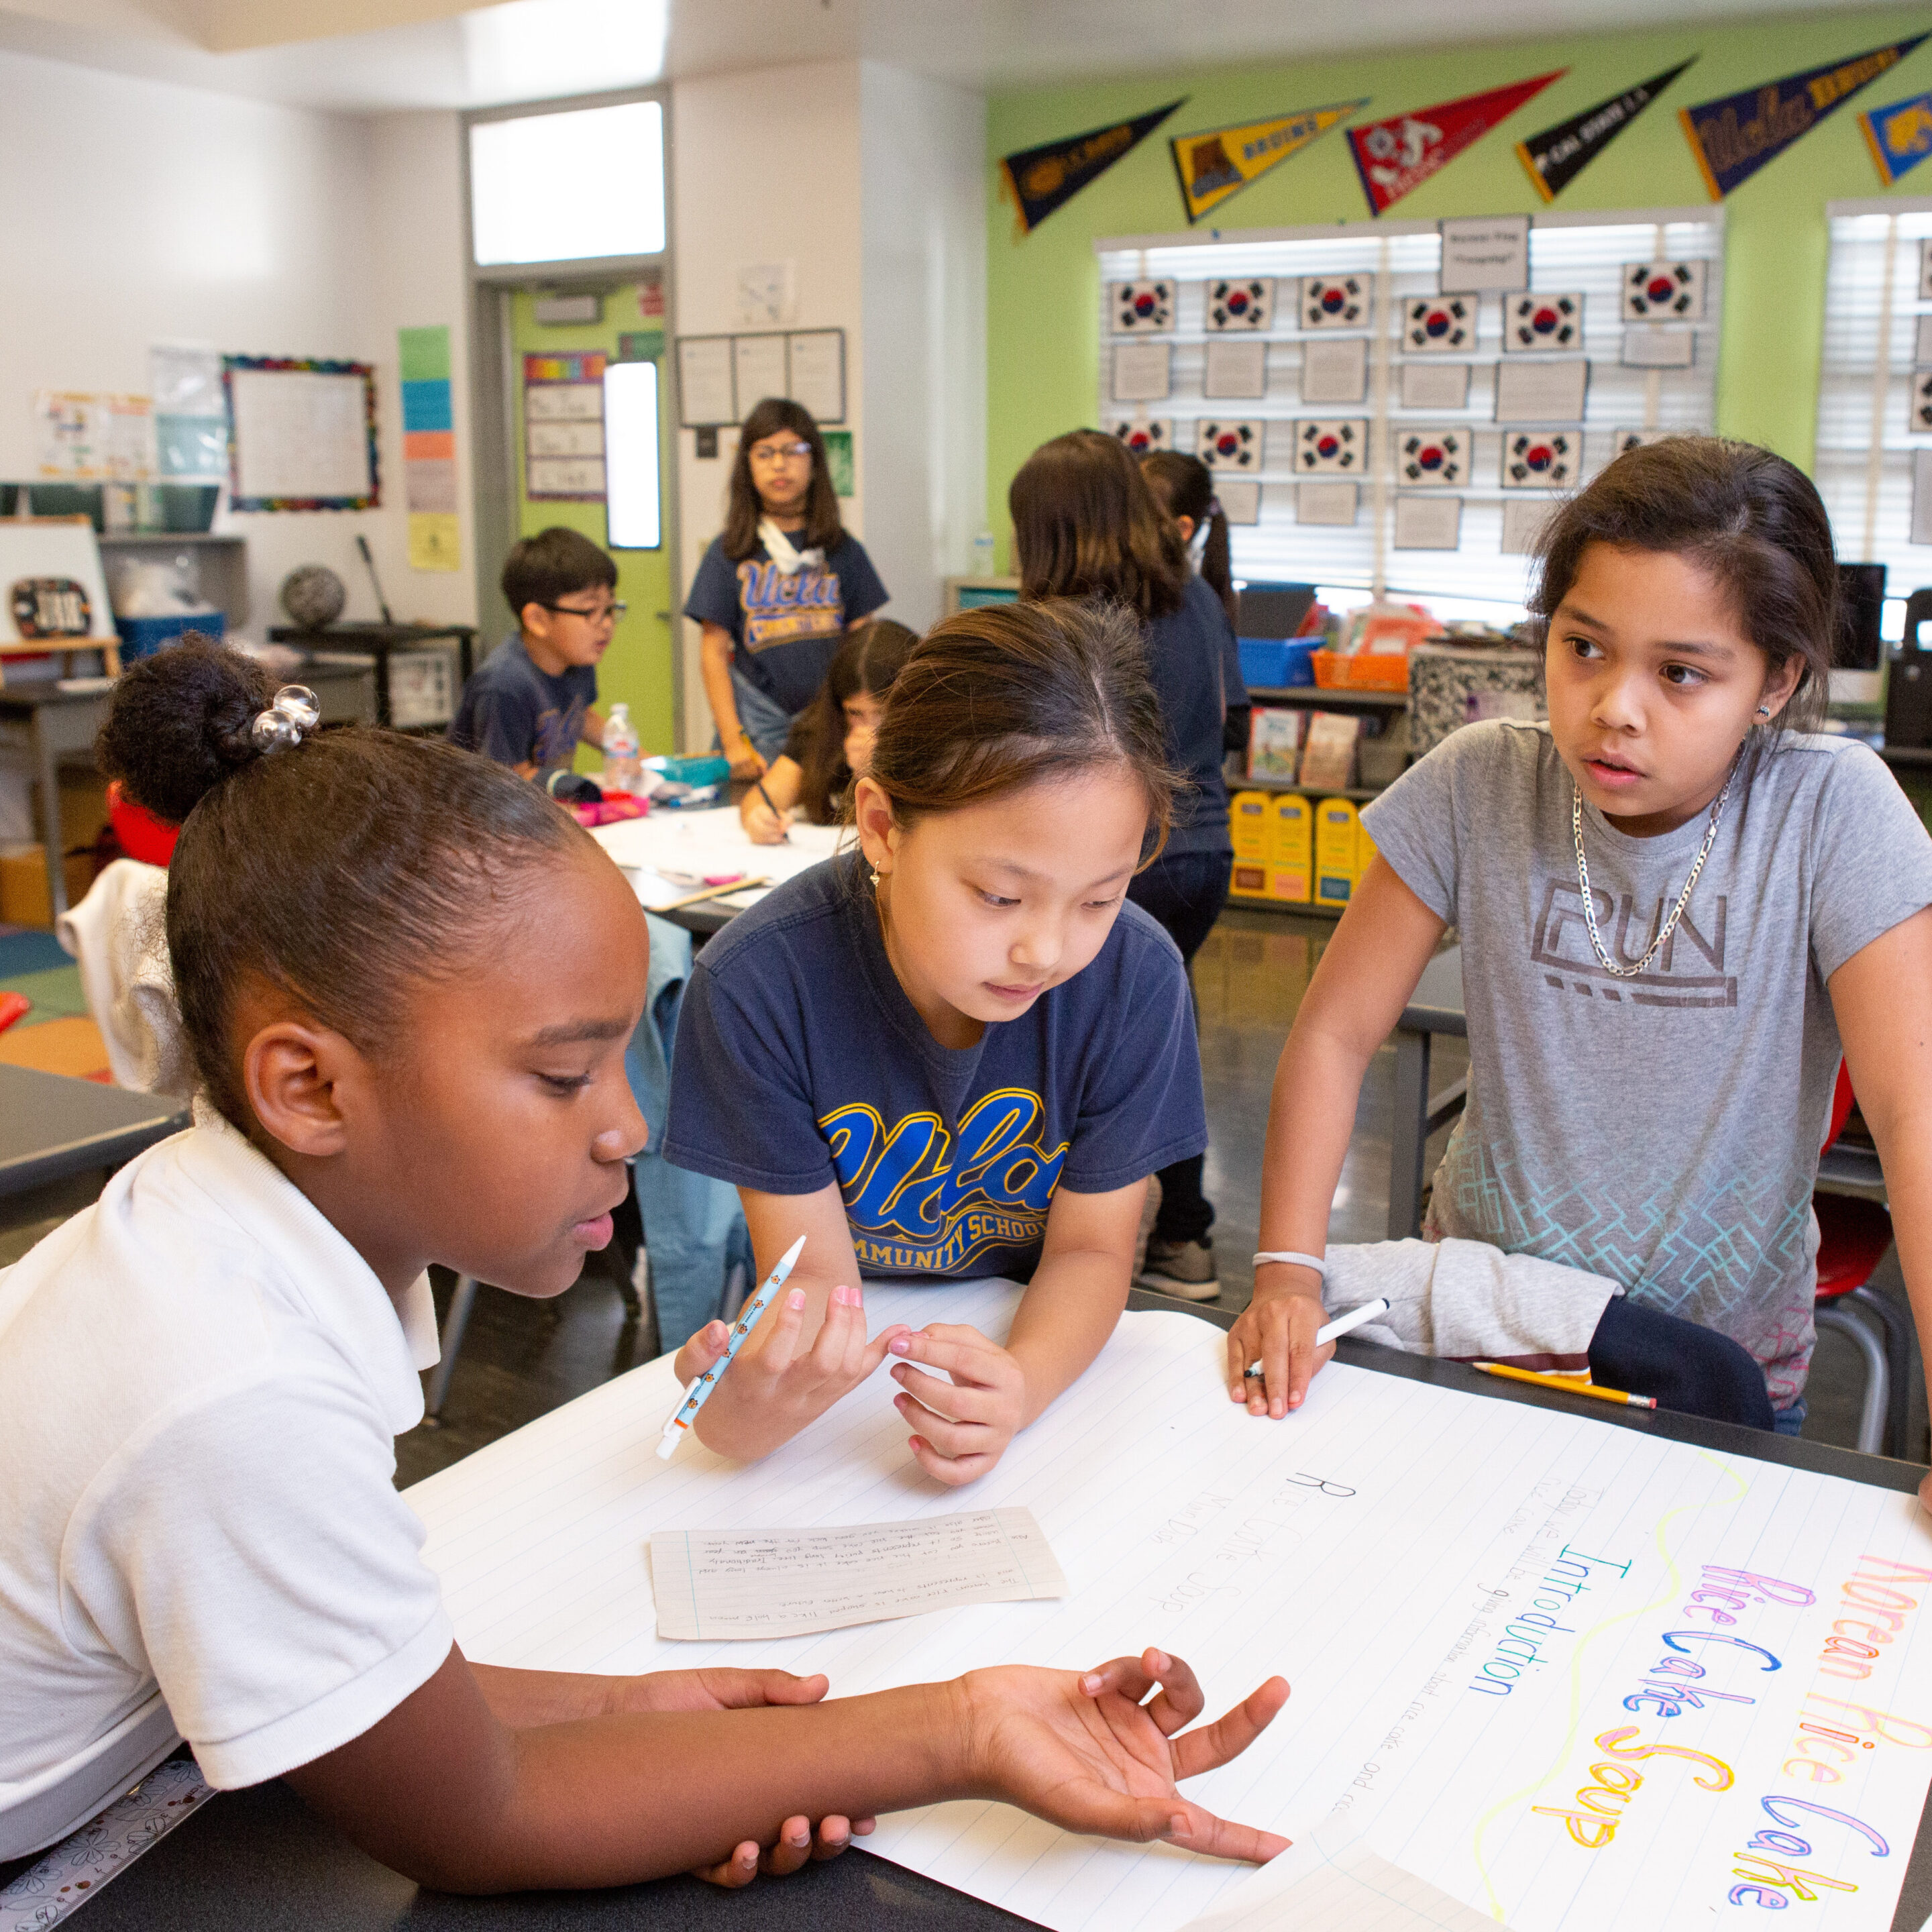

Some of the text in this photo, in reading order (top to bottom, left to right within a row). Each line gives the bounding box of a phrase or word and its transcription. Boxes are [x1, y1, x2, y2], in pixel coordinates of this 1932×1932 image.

[1532, 877, 1727, 973] RUN
[818, 1087, 1071, 1238] Ucla
[853, 1224, 965, 1269] MMUNITY
[1468, 1544, 1632, 1695] Introduction
[1532, 1564, 1817, 1848] Rice Cake Soup
[1727, 1554, 1932, 1909] Korean Rice Cake
